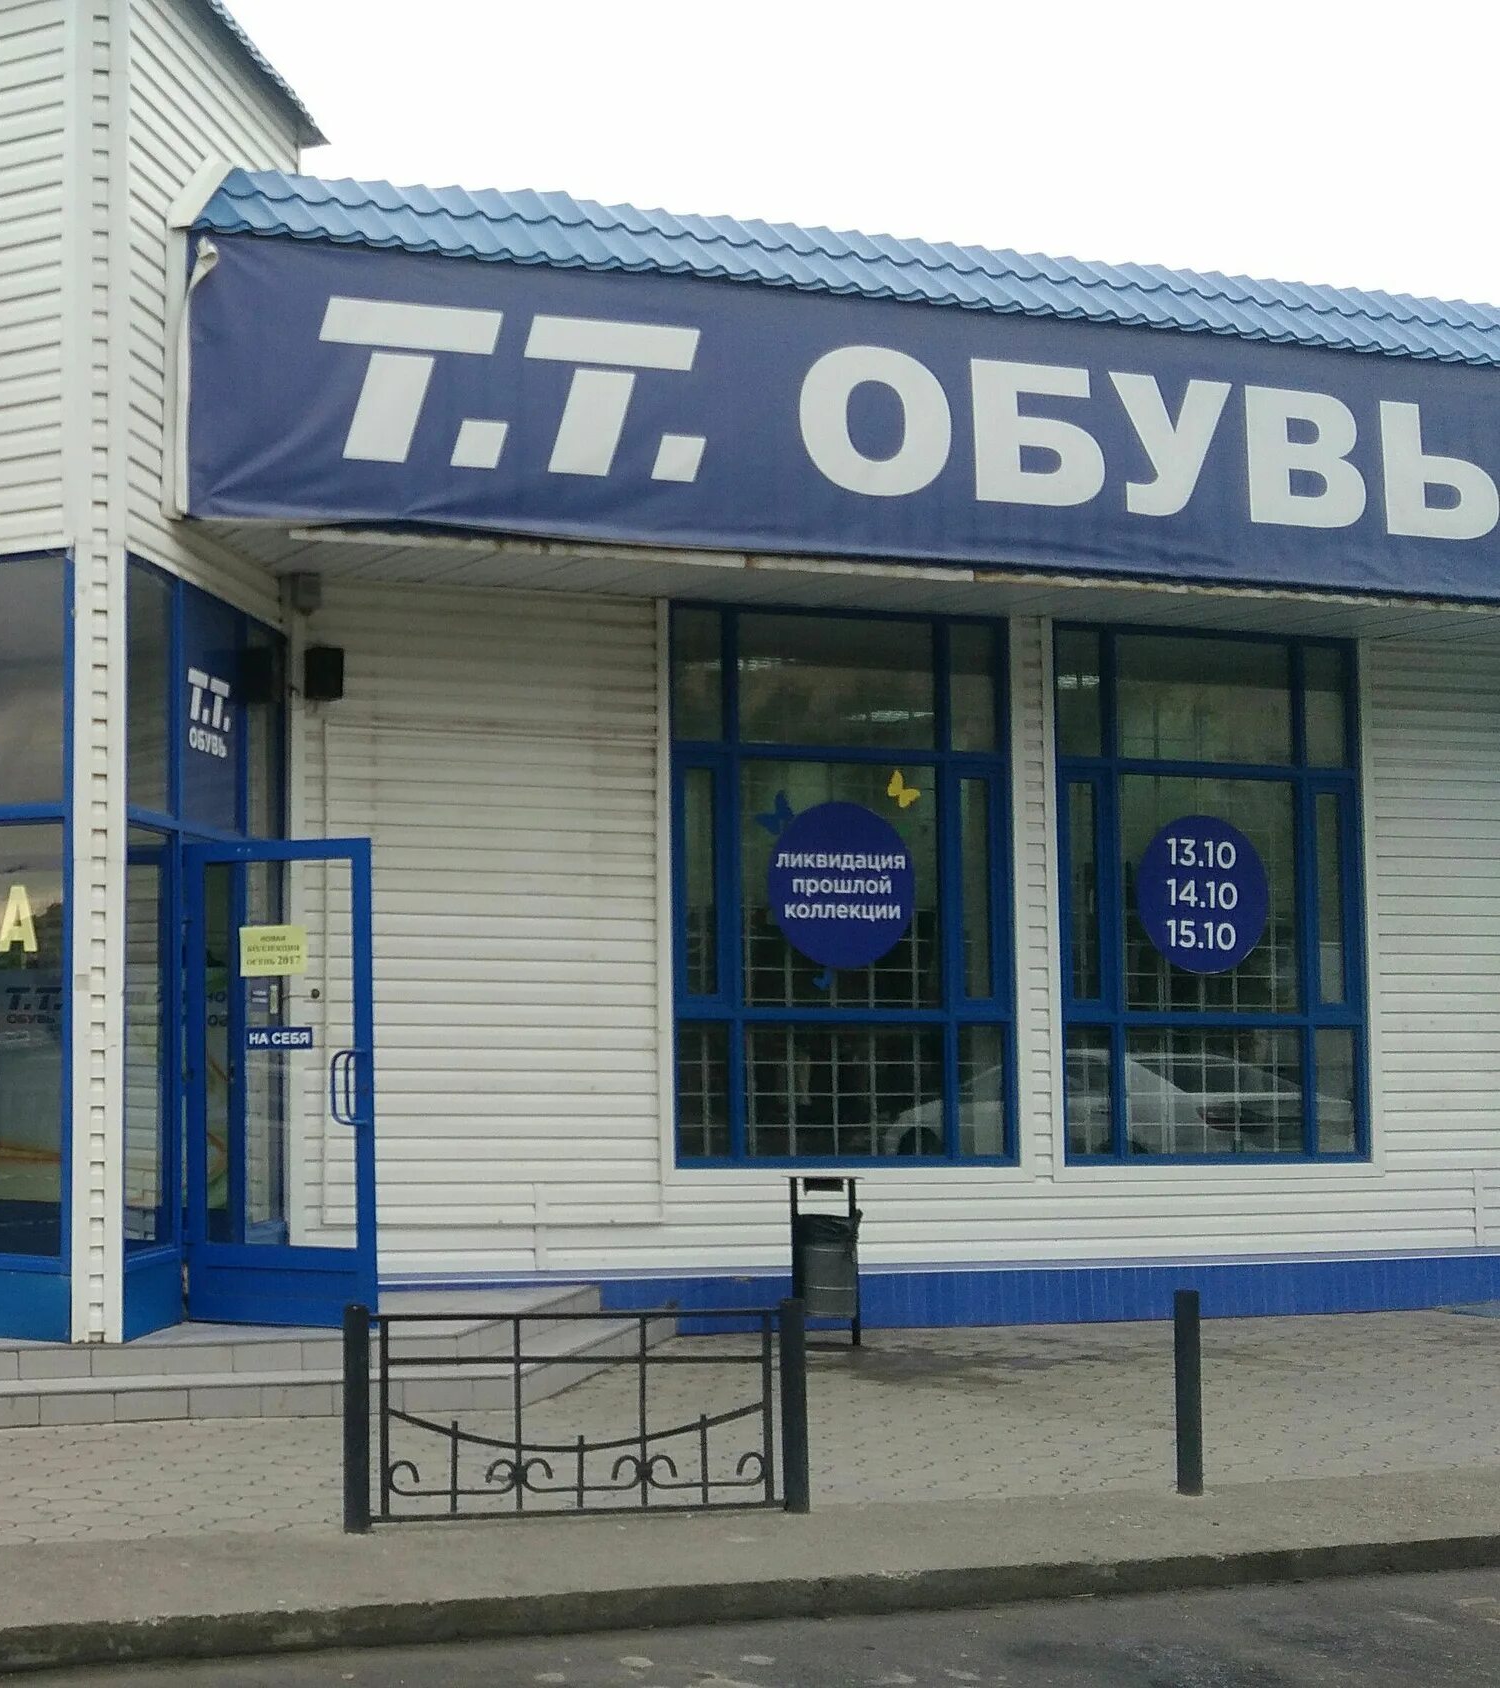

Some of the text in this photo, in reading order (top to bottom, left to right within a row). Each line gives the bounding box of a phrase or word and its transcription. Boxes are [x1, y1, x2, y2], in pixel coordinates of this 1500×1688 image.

[317, 296, 1500, 541] Т.Т. ОБУВЬ
[187, 667, 230, 732] Т.Т.
[188, 726, 228, 758] ОБУВЬ
[775, 853, 906, 872] ликвидация
[1166, 838, 1237, 869] 13.10
[792, 875, 892, 896] прошлой
[1166, 879, 1238, 910] 14.10
[784, 903, 901, 922] коллекции
[1166, 919, 1237, 951] 15.10
[248, 1031, 310, 1046] НА СЕБЯ
